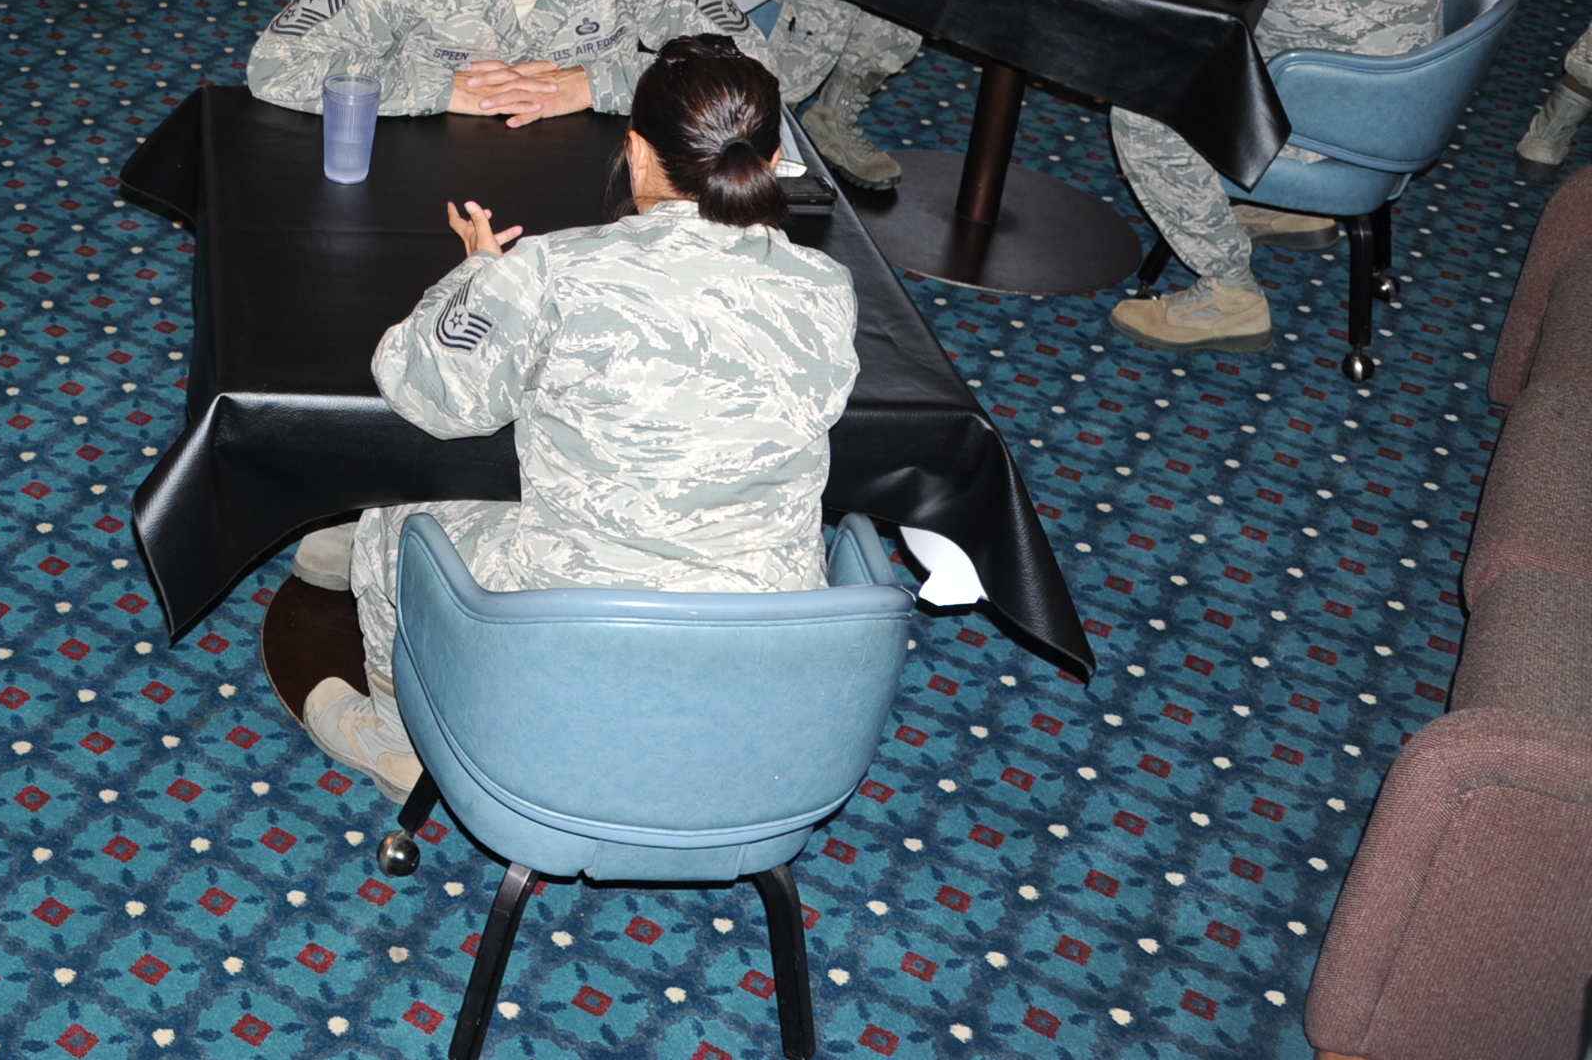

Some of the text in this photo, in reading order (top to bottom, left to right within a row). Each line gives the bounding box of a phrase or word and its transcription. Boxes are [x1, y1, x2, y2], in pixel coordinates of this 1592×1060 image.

[433, 48, 470, 61] SPEEN
[553, 25, 628, 61] U.S. AIR FORCE
